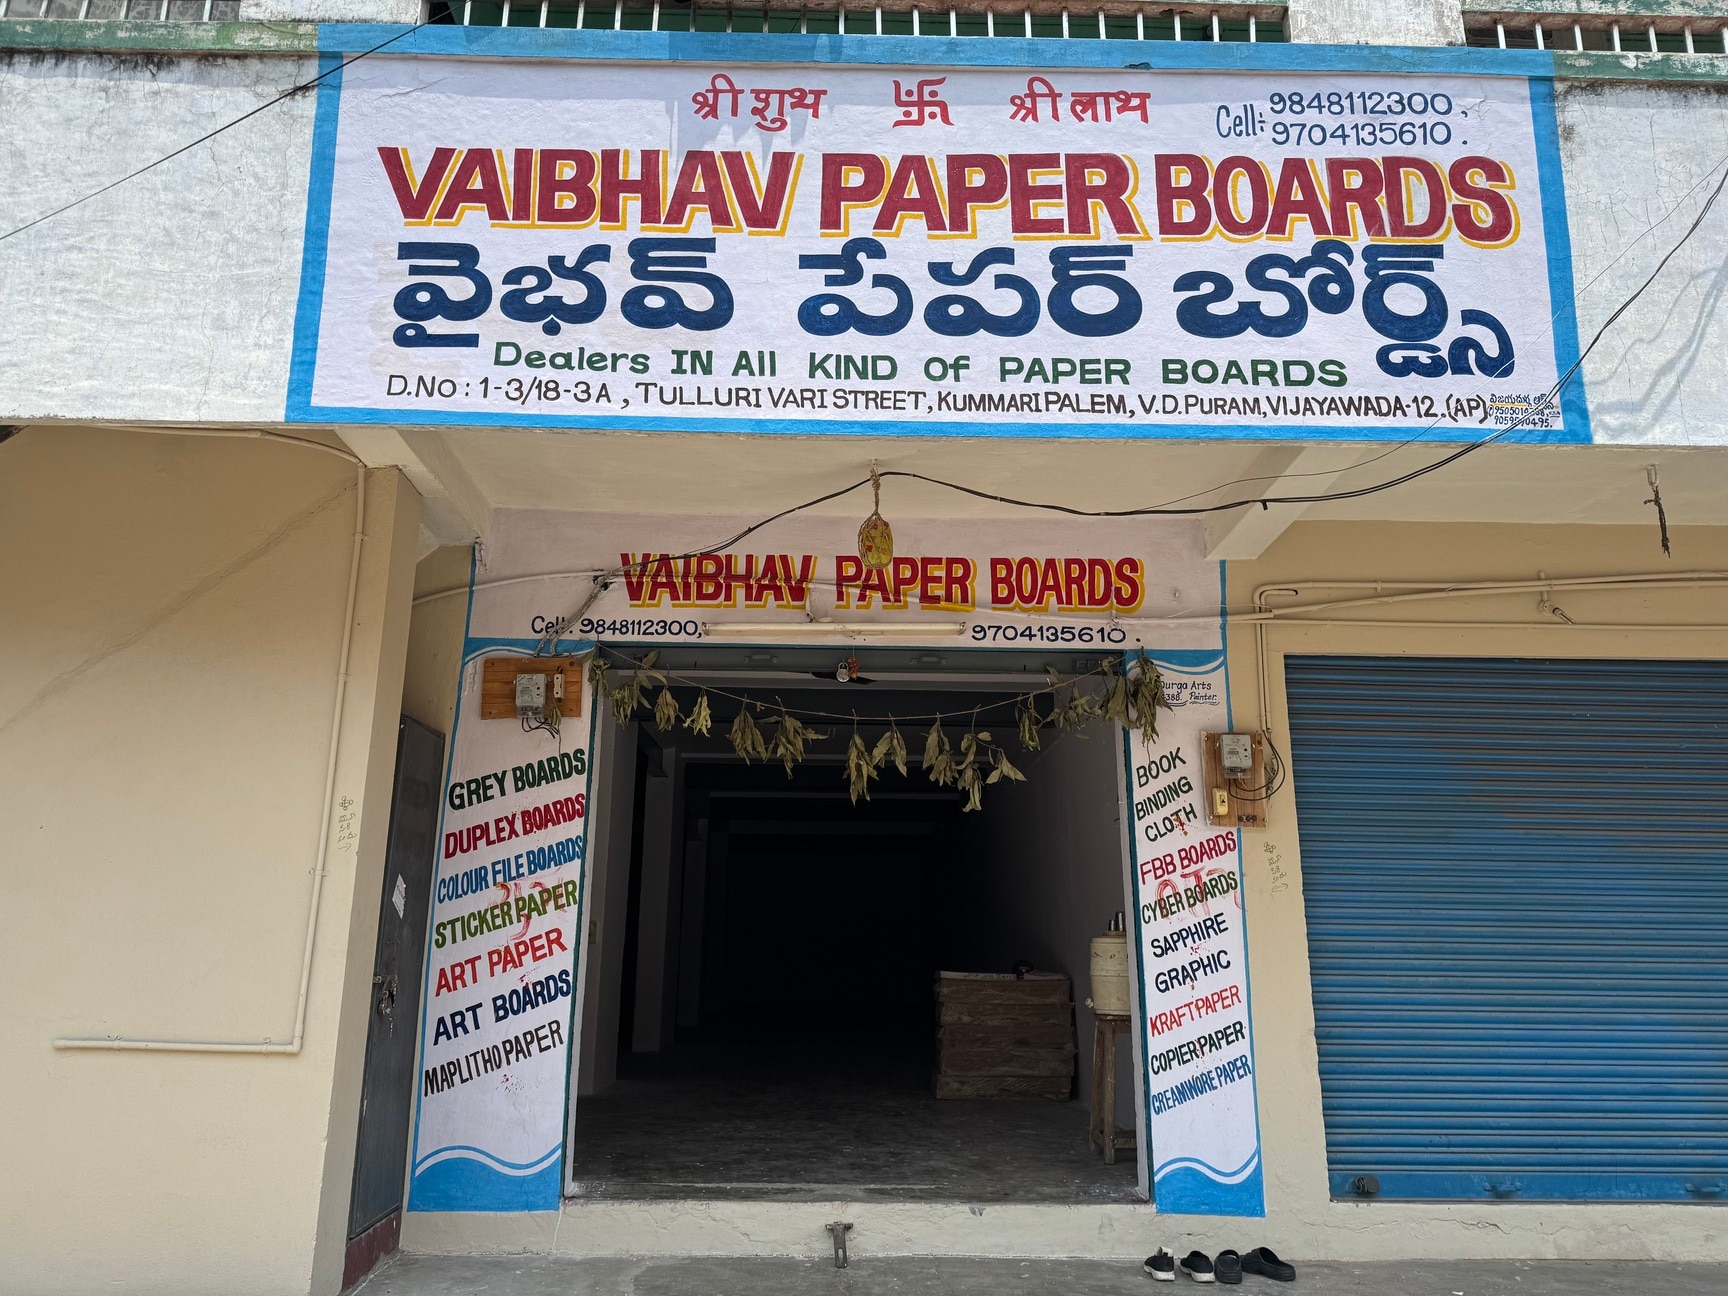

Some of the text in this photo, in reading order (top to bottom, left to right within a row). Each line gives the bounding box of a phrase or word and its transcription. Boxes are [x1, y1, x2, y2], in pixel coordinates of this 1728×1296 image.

[691, 73, 745, 120] श्री
[1009, 76, 1063, 123] श्री
[377, 146, 1521, 249] VAIBHAV PAPER BOARDS
[393, 237, 734, 348] వైభవ్
[797, 237, 1143, 337] పేపర్
[493, 341, 1348, 387] Dealers IN All KIND Of PAPER BOARDS
[620, 552, 1145, 614] VAIBHAV PAPER BOARDS
[1190, 680, 1212, 691] Arts
[448, 748, 586, 811] GREY BOARDS
[1136, 746, 1187, 788] BOOK
[444, 793, 586, 859] DUPLEX BOARDS
[1135, 775, 1194, 822] BINDING
[1144, 802, 1198, 842] CLOTH
[437, 865, 490, 904] COLOUR
[491, 853, 526, 886] FILE
[525, 835, 584, 876] BOARDS
[1139, 853, 1177, 885] FBB
[1177, 830, 1237, 870] BOARDS
[434, 901, 514, 949] STICKER
[514, 879, 578, 924] PAPER
[1141, 891, 1186, 925] CYBER
[1183, 870, 1238, 909] BOARDS
[1150, 911, 1229, 958] SAPPHIRE
[435, 927, 568, 998] ART PAPER
[1154, 949, 1231, 994] GRAPHIC
[433, 969, 572, 1046] ART BOARDS
[424, 1019, 564, 1097] MAPLITHO PAPER
[1214, 1054, 1252, 1088] PAPER
